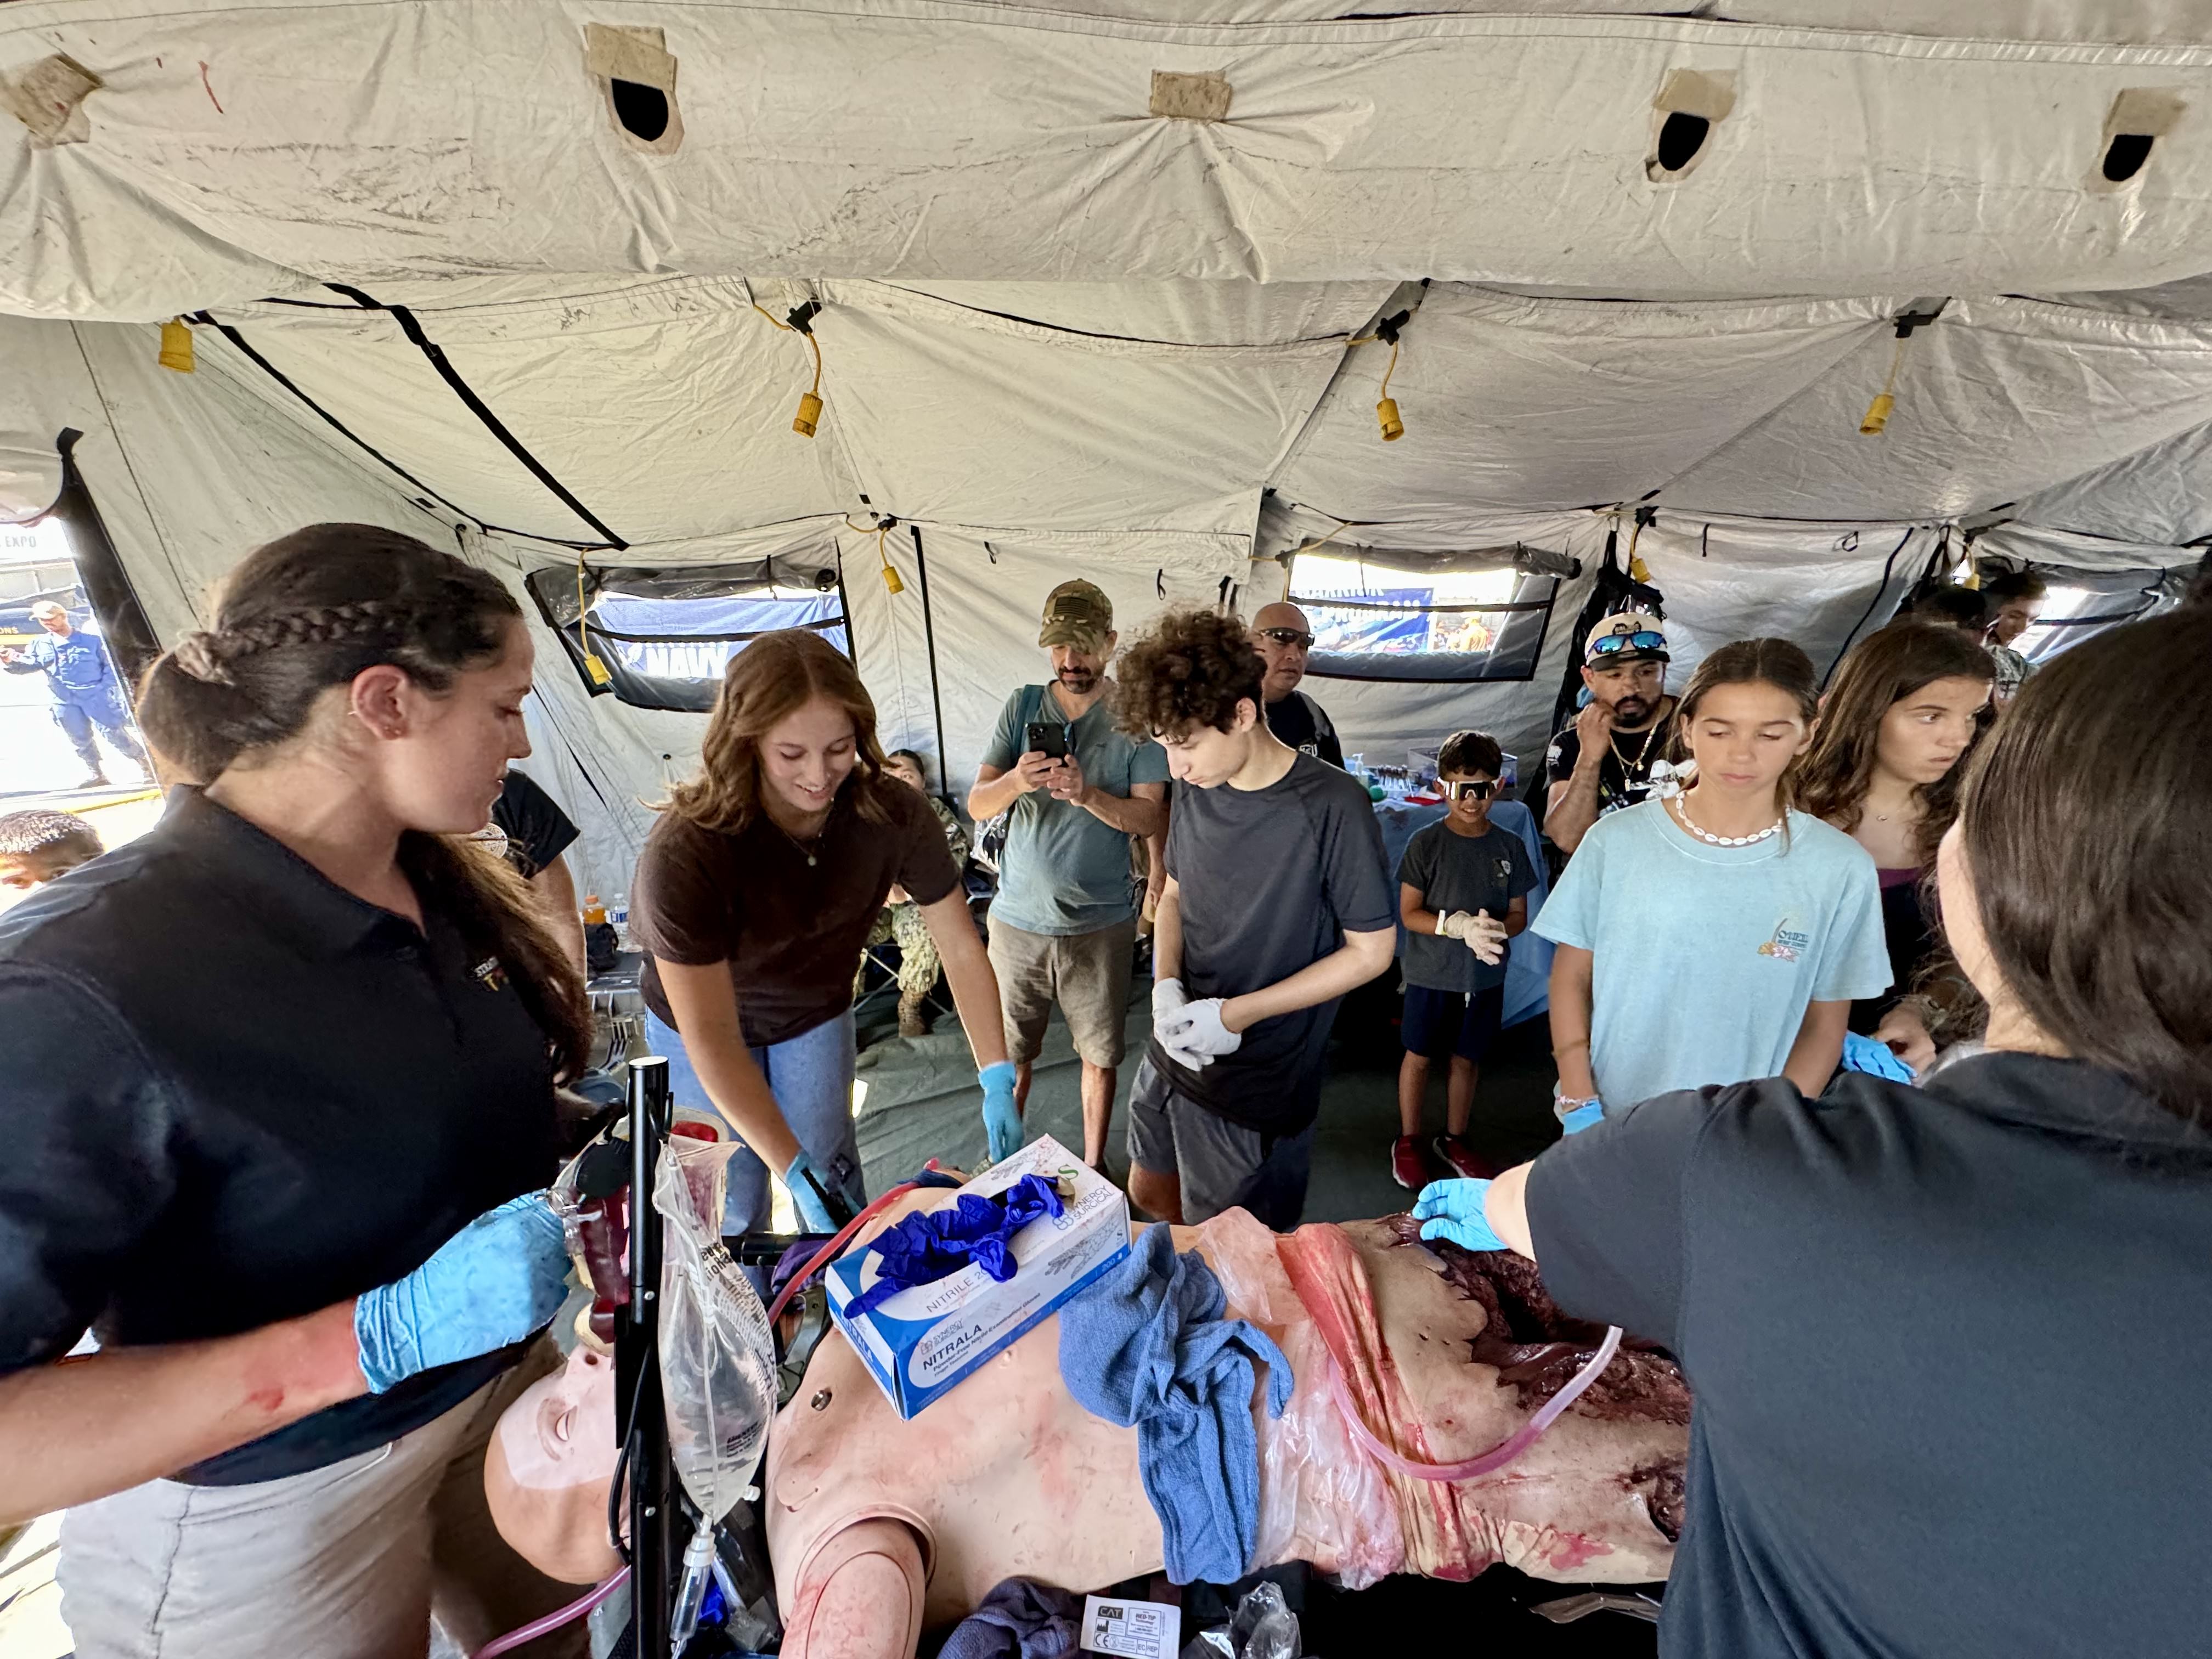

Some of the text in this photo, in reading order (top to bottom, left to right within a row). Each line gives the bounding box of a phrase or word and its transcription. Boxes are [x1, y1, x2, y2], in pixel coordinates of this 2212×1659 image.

[5, 536, 36, 548] EXPO
[646, 647, 731, 679] NAVY
[1058, 1164, 1079, 1180] S
[1074, 1192, 1115, 1220] SURGICAL
[1102, 1258, 1115, 1272] 200
[926, 1277, 974, 1313] NITRILE
[923, 1324, 983, 1370] NITRALA
[933, 1344, 970, 1372] Powder-Free
[1099, 1607, 1122, 1619] CAT
